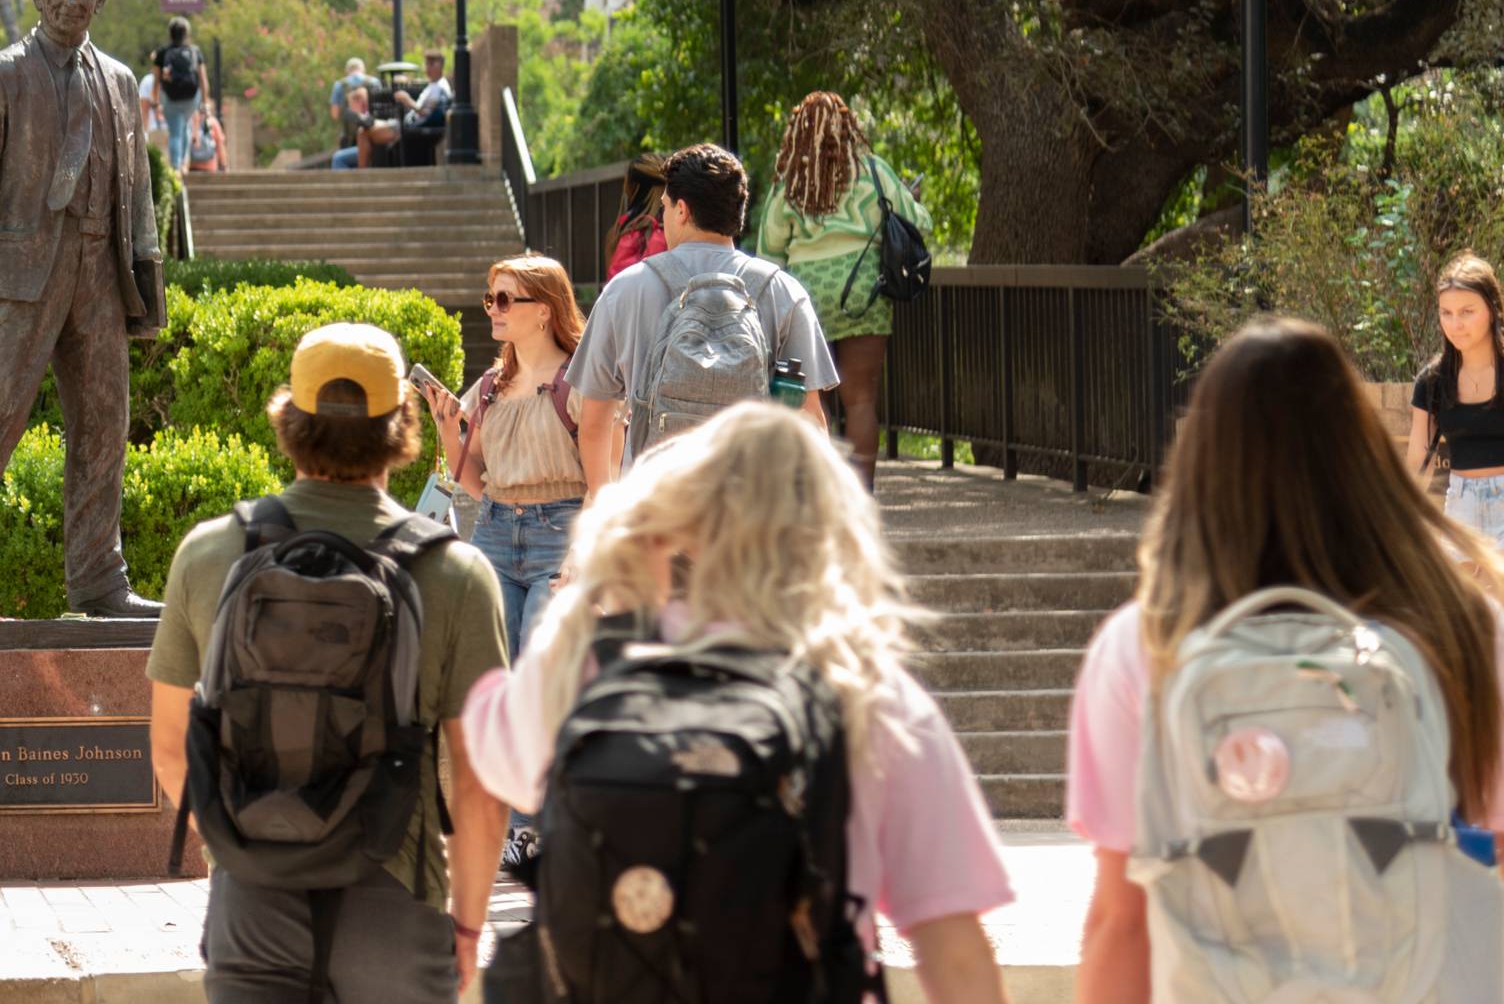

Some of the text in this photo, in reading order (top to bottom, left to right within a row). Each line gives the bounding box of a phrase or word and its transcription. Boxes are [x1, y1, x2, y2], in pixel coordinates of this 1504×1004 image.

[18, 748, 69, 761] Baines
[75, 746, 142, 760] Johnson
[5, 773, 88, 786] Class of 1930
